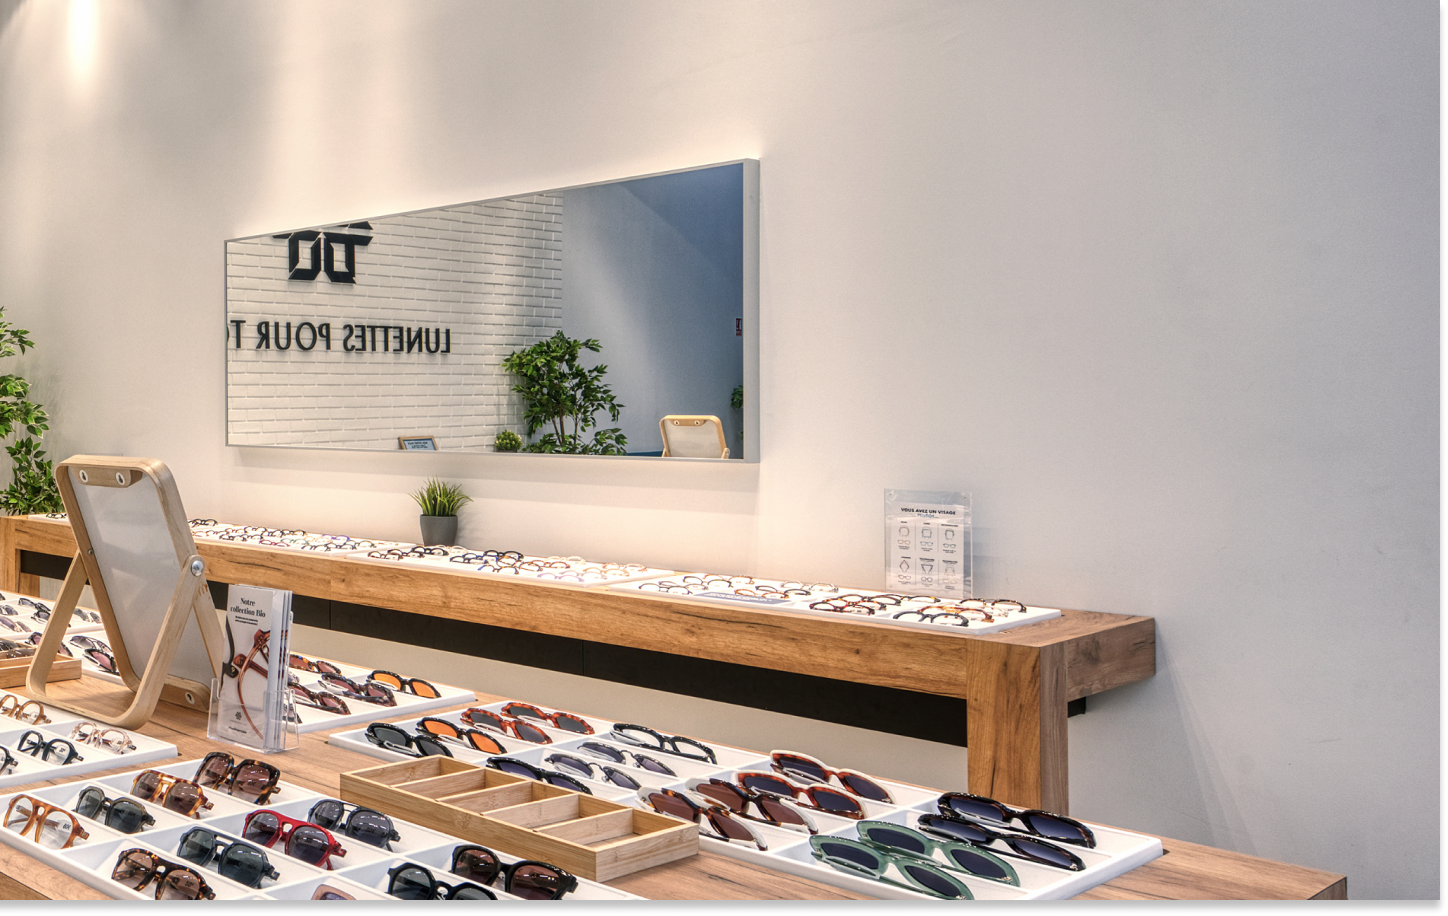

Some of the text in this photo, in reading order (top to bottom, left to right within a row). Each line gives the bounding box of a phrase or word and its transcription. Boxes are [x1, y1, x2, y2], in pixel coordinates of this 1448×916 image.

[241, 598, 255, 606] Notre
[230, 606, 265, 617] collection Bio
